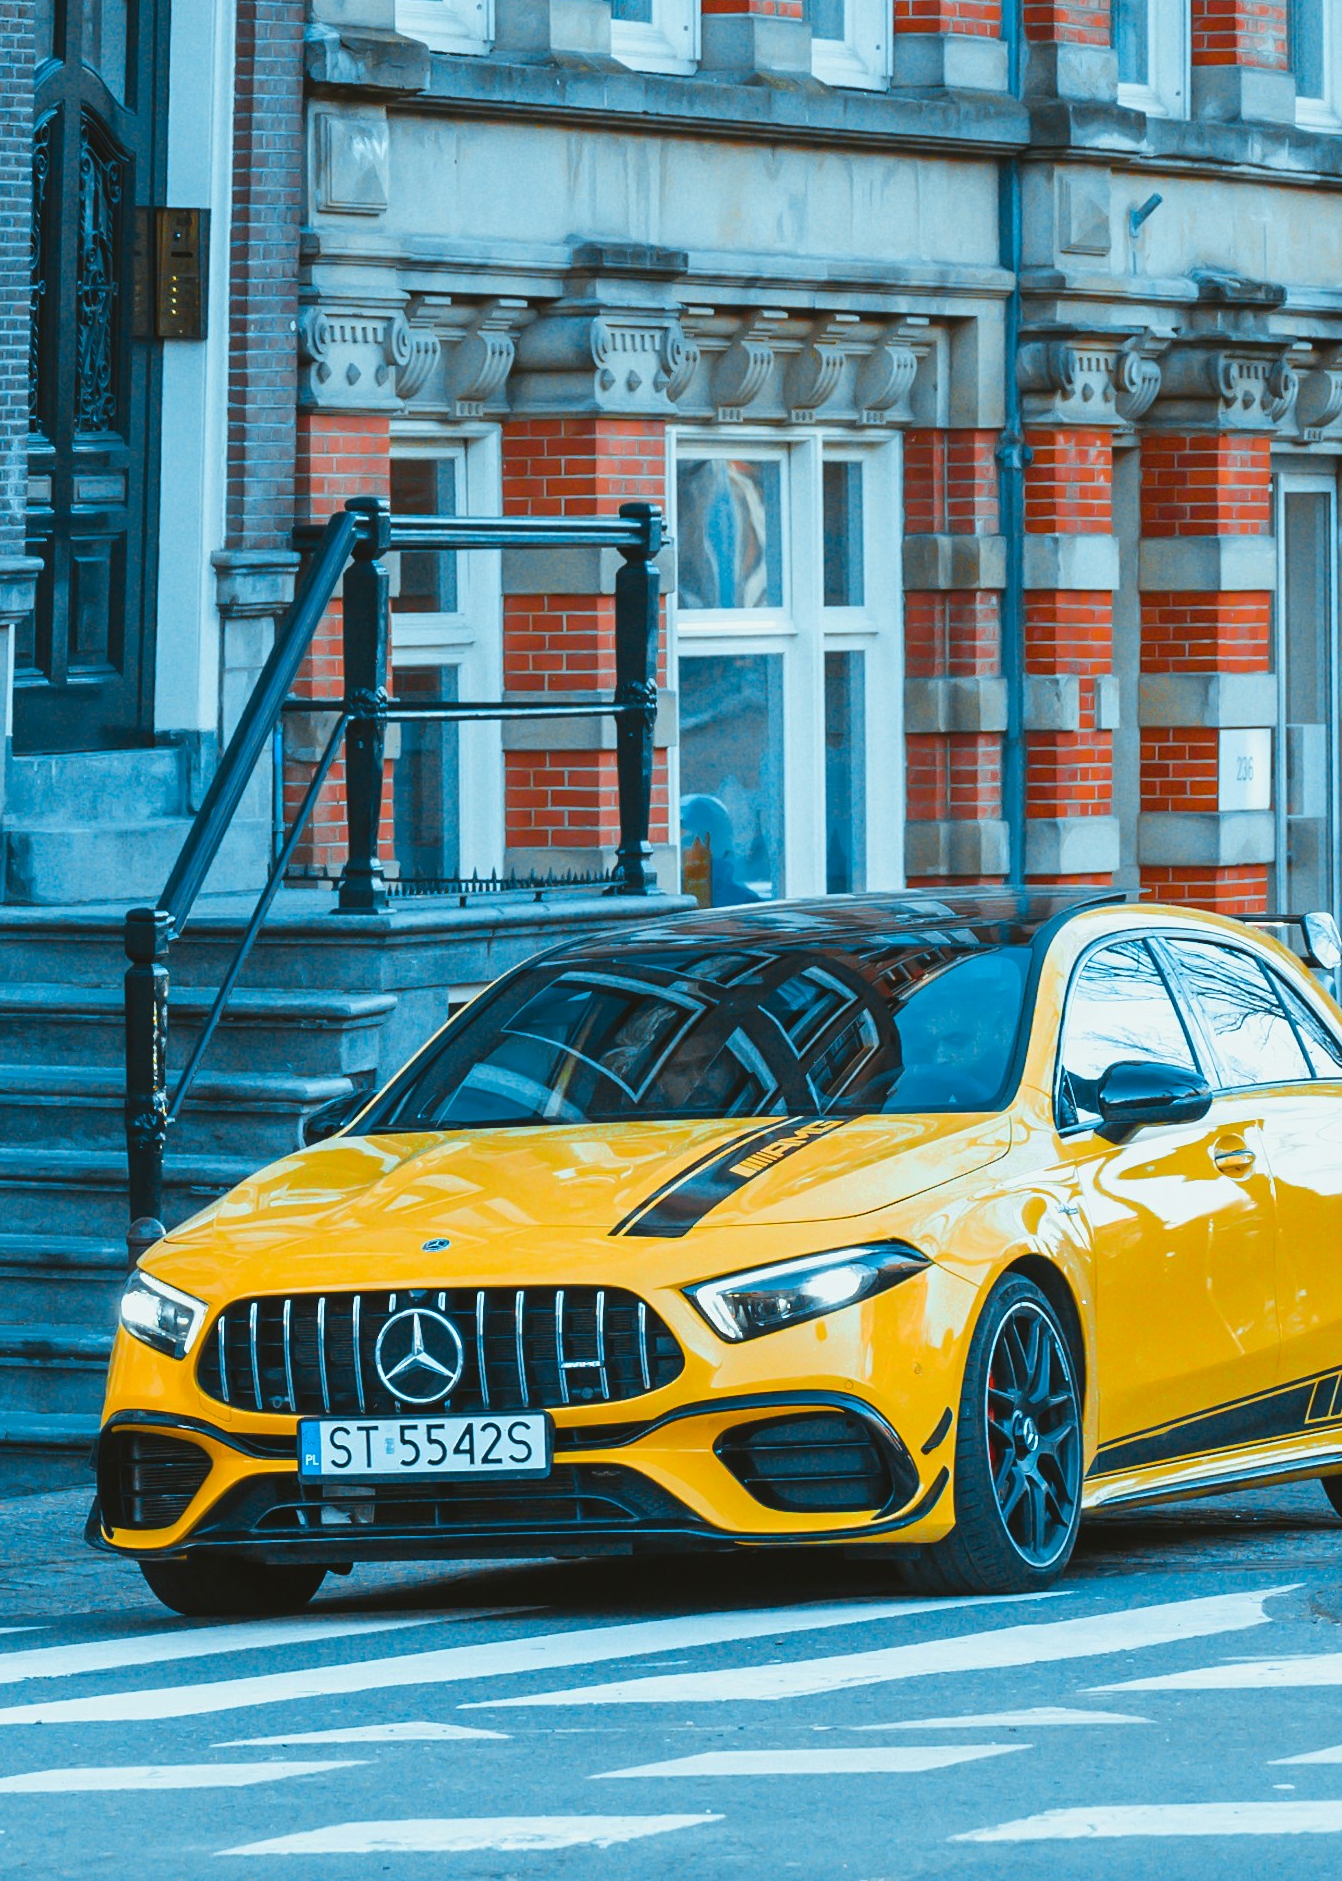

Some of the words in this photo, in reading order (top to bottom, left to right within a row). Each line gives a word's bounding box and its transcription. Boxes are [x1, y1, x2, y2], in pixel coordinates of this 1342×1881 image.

[305, 1454, 320, 1466] PL
[329, 1425, 379, 1468] ST
[399, 1421, 532, 1467] 5542S
